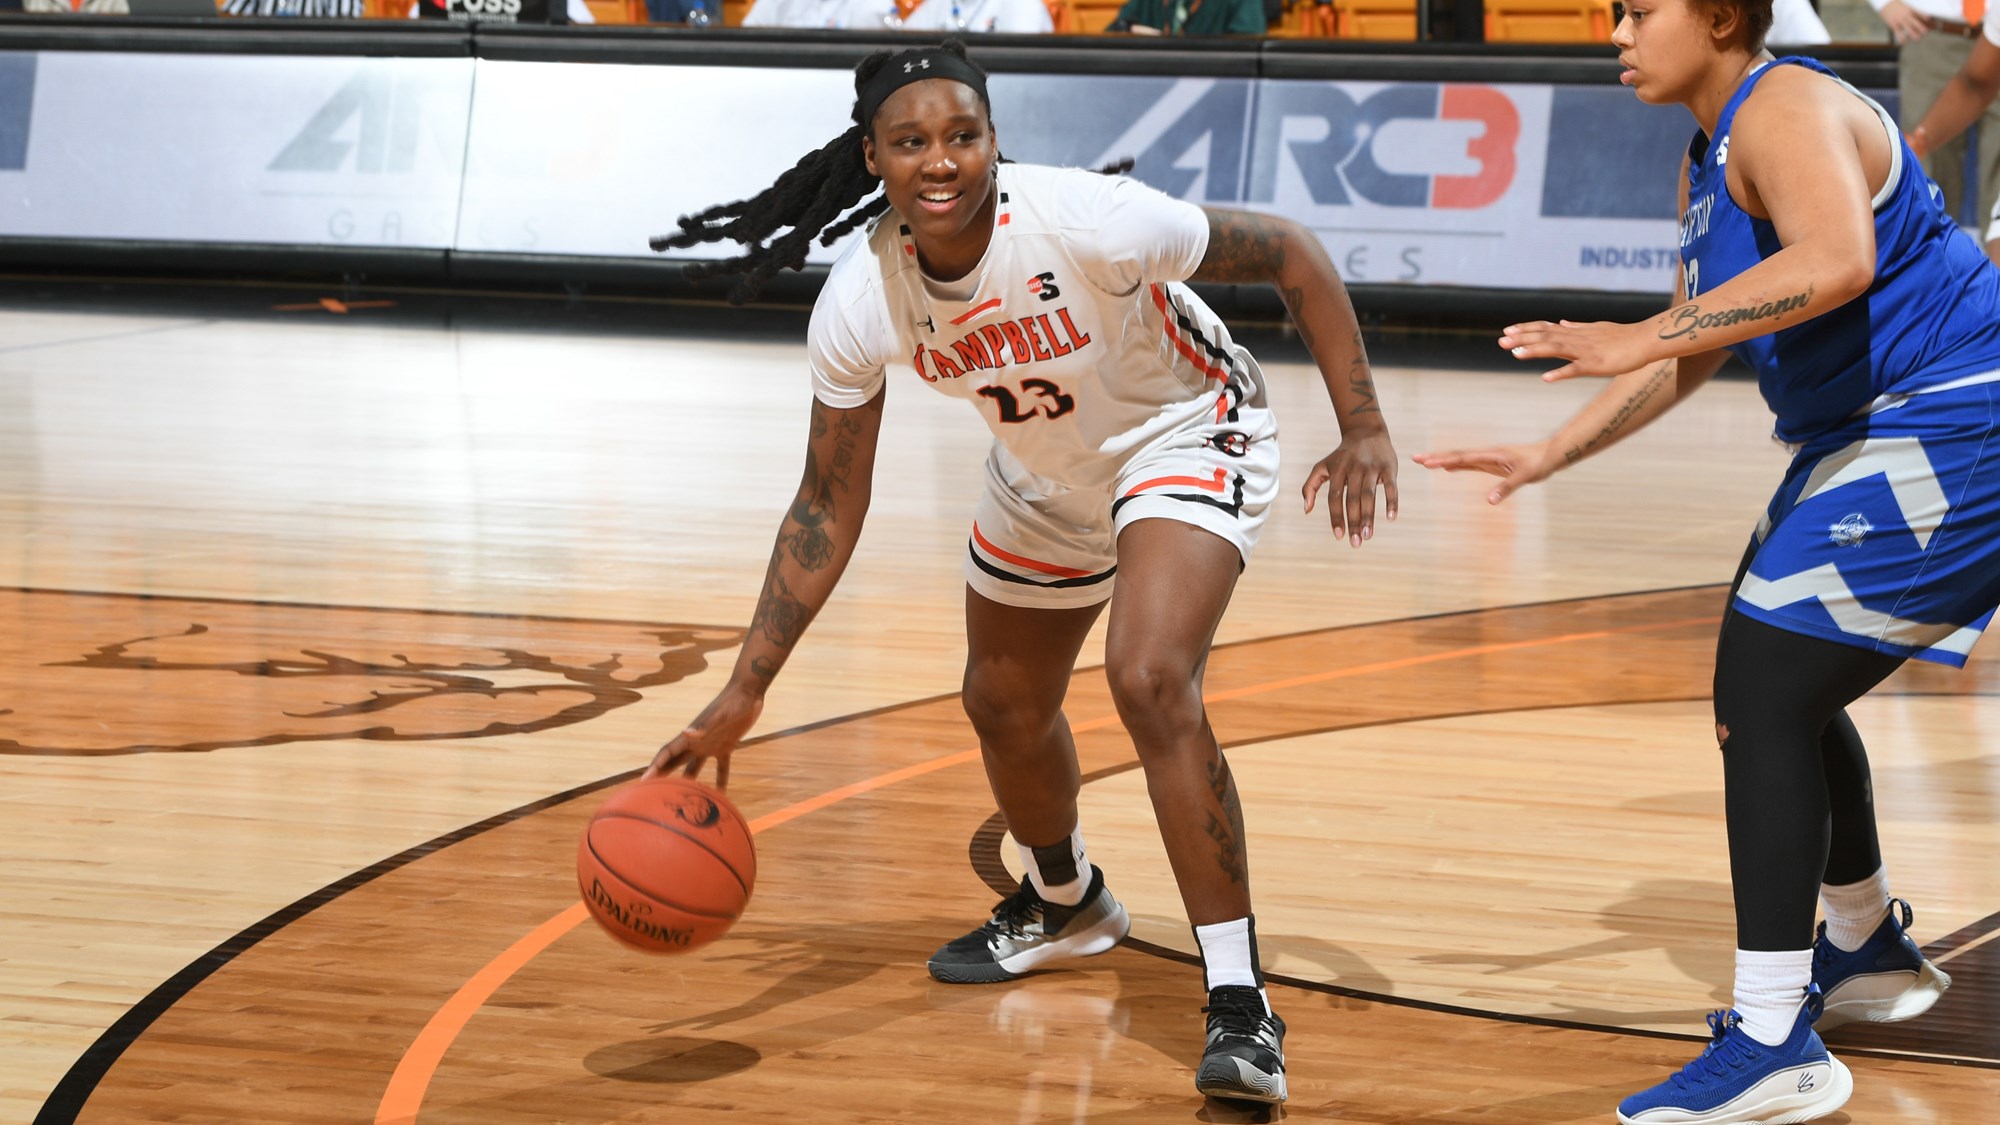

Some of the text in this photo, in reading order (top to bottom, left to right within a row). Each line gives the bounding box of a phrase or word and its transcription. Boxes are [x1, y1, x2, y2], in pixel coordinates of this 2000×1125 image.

[1579, 245, 1680, 270] INDUSTR
[1658, 287, 1811, 340] Bossmann
[914, 306, 1091, 383] CAMPBELL
[975, 376, 1075, 424] 23
[587, 876, 694, 947] SPALDING
